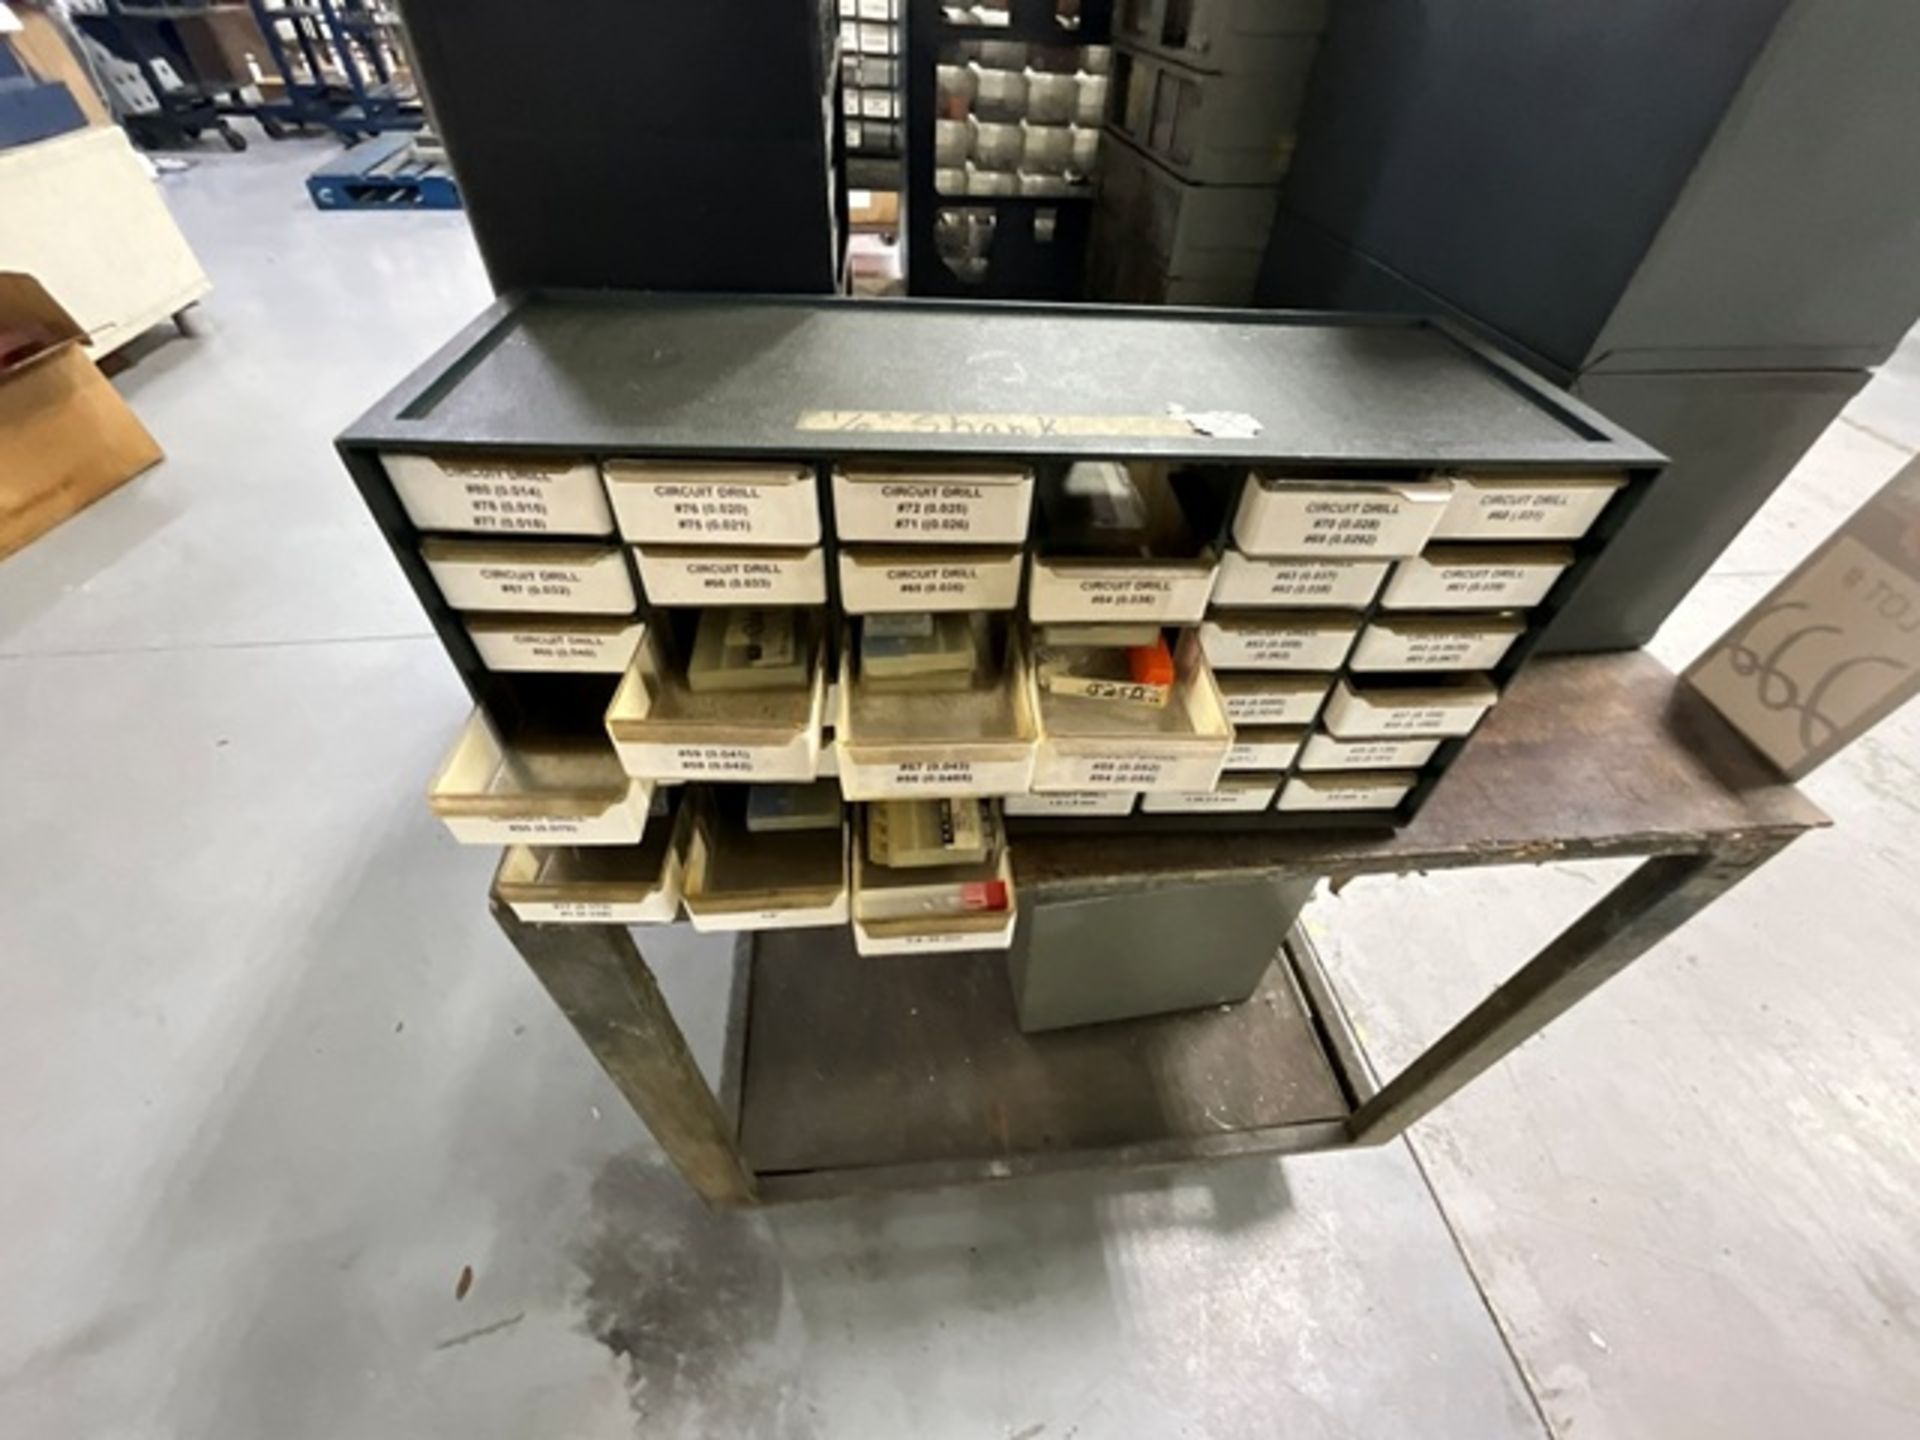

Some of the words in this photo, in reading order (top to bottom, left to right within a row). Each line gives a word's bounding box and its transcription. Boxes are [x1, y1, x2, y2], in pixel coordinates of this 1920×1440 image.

[654, 486, 713, 498] CIRCUIT
[717, 487, 761, 499] DRILL
[881, 486, 938, 498] CIRCUIT
[941, 487, 982, 498] DRILL
[1480, 494, 1531, 506] CIRCUIT
[1533, 494, 1568, 507] DRILL
[1305, 502, 1359, 514] CIRCUIT
[1361, 503, 1399, 514] DRILL
[687, 564, 740, 574] CIRCUIT
[743, 564, 782, 574] DRILL
[886, 569, 939, 580] CIRCUIT
[942, 570, 977, 580] DRILL
[1441, 569, 1490, 580] CIRCUIT
[1490, 569, 1524, 580] DRILL
[480, 569, 535, 581] CIRCUIT
[539, 571, 581, 582] DRILL
[1079, 581, 1131, 592] CIRCUIT
[1134, 582, 1171, 592] DRILL
